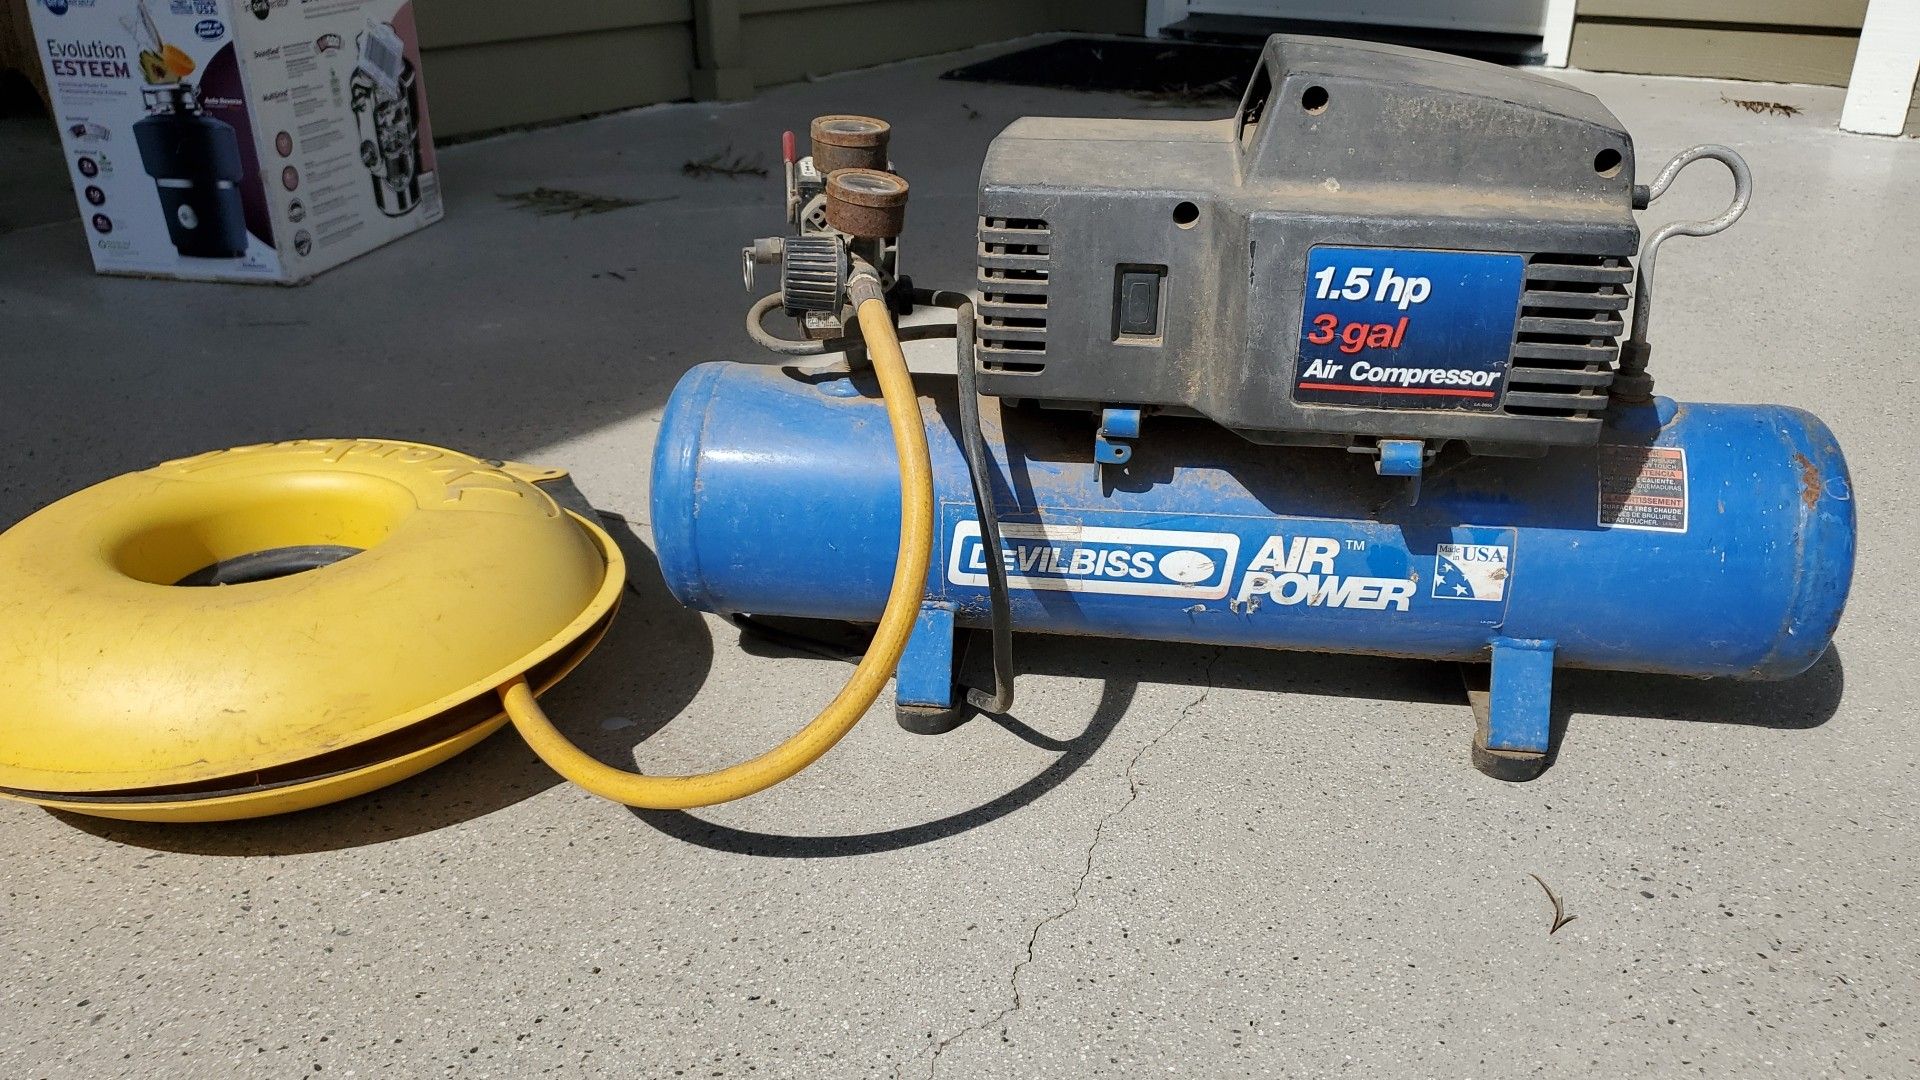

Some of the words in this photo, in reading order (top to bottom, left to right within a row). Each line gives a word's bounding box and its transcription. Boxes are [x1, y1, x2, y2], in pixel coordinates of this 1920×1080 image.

[47, 39, 126, 59] Evolution
[52, 60, 130, 78] ESTEEM
[1315, 267, 1373, 300] 1.5
[1375, 268, 1431, 310] hp
[1308, 314, 1338, 345] 3
[1339, 317, 1409, 353] gal
[1303, 359, 1343, 379] Air
[1350, 361, 1501, 387] Compressor
[1653, 507, 1683, 515] CHAUDE.
[1247, 535, 1341, 575] AIR
[1439, 545, 1460, 553] Made
[1463, 546, 1505, 563] USA
[1236, 571, 1417, 612] POWER
